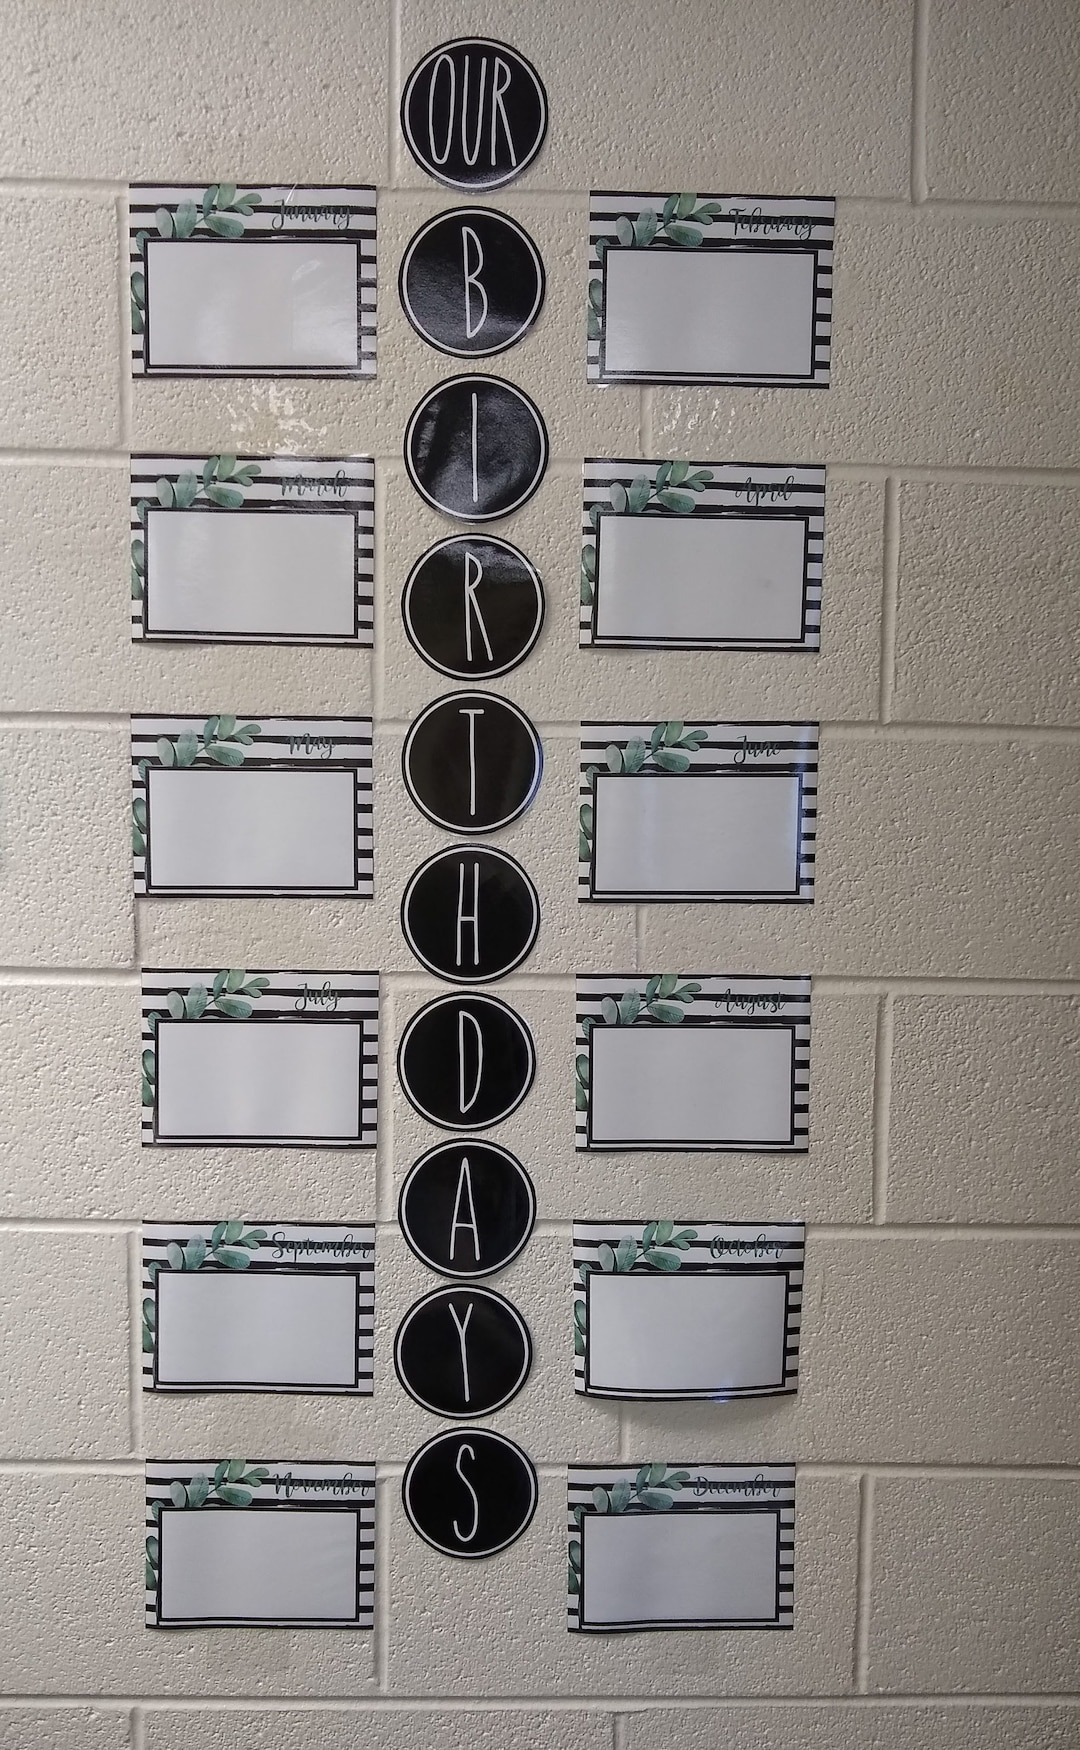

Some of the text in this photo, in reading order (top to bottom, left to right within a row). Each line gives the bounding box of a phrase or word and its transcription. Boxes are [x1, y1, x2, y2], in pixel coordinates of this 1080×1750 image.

[428, 55, 516, 165] OUR
[272, 199, 354, 230] January
[729, 206, 817, 241] February
[281, 469, 347, 497] March
[735, 475, 794, 507] April
[287, 733, 335, 760] May
[734, 735, 781, 765] June
[295, 981, 340, 1012] July
[715, 988, 786, 1016] August
[272, 1231, 370, 1264] September
[710, 1233, 783, 1259] October
[273, 1472, 370, 1498] November
[693, 1474, 780, 1498] December
